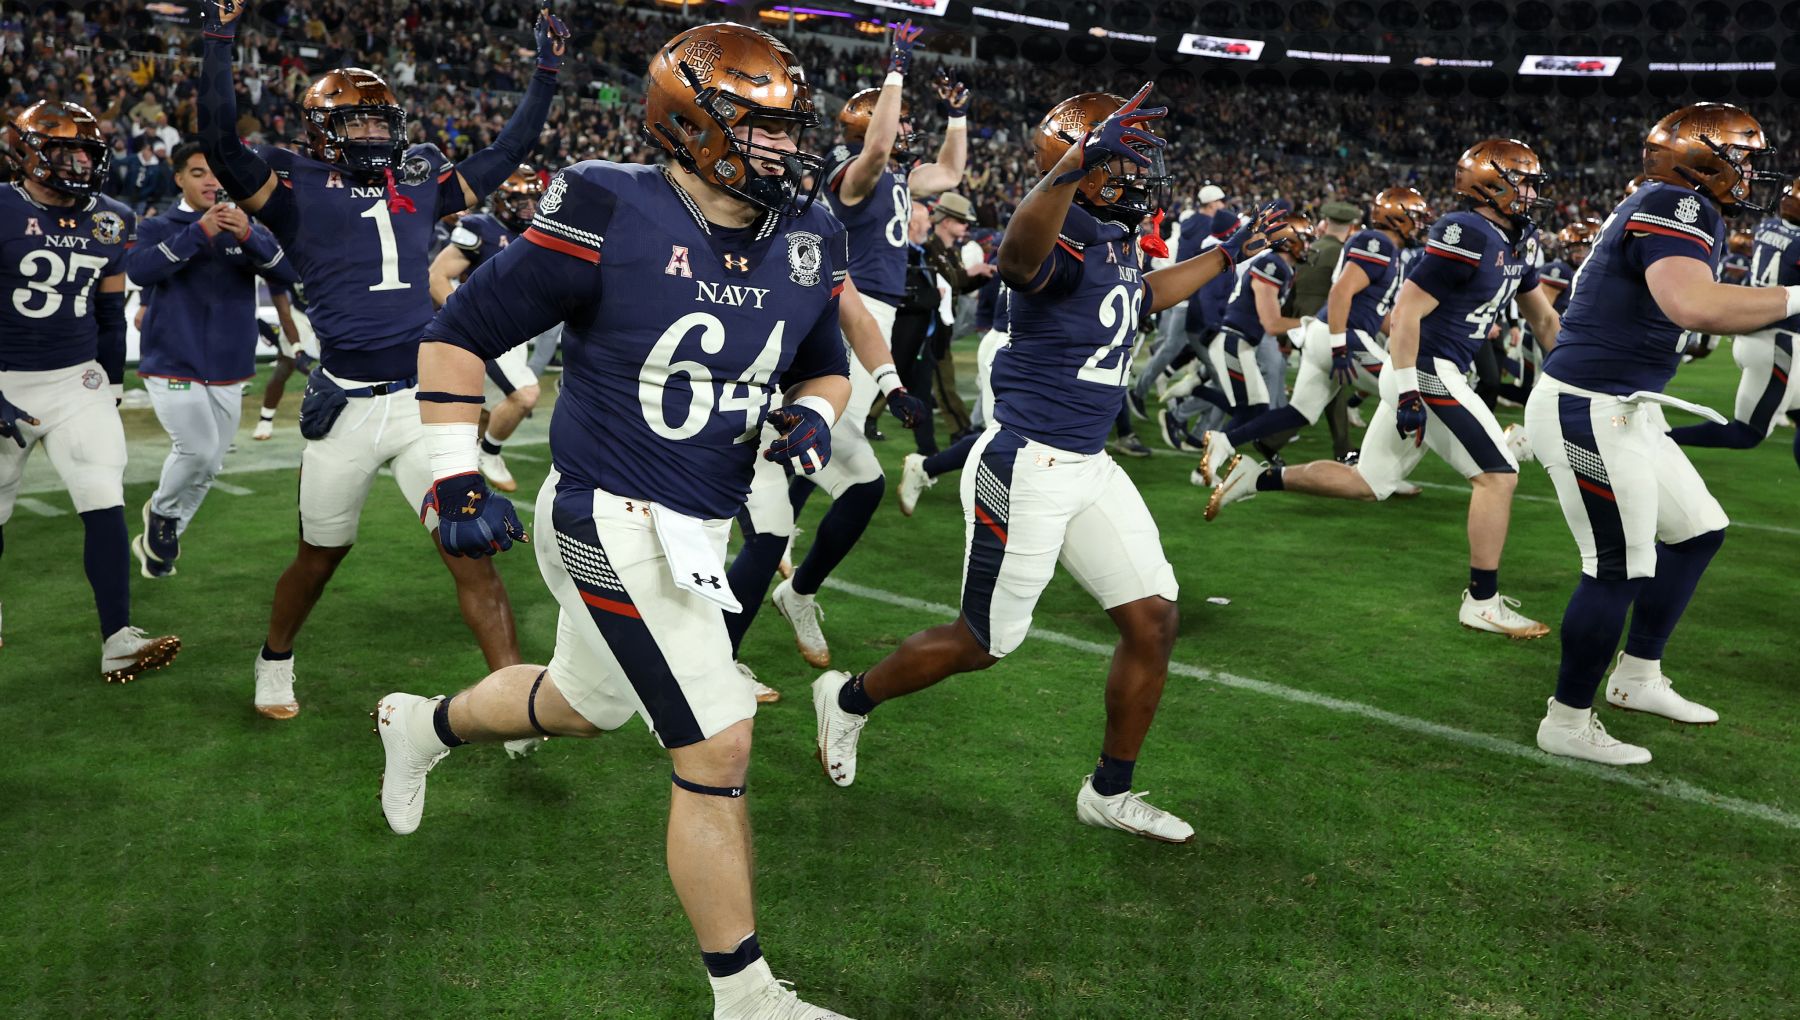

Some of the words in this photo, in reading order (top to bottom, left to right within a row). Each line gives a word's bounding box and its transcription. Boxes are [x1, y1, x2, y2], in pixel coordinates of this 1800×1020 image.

[44, 234, 91, 249] NAVY
[360, 199, 411, 291] 1
[885, 184, 912, 247] 8
[12, 249, 109, 318] 37
[695, 280, 771, 309] NAVY
[1118, 264, 1138, 283] NAVY
[638, 311, 786, 445] 64
